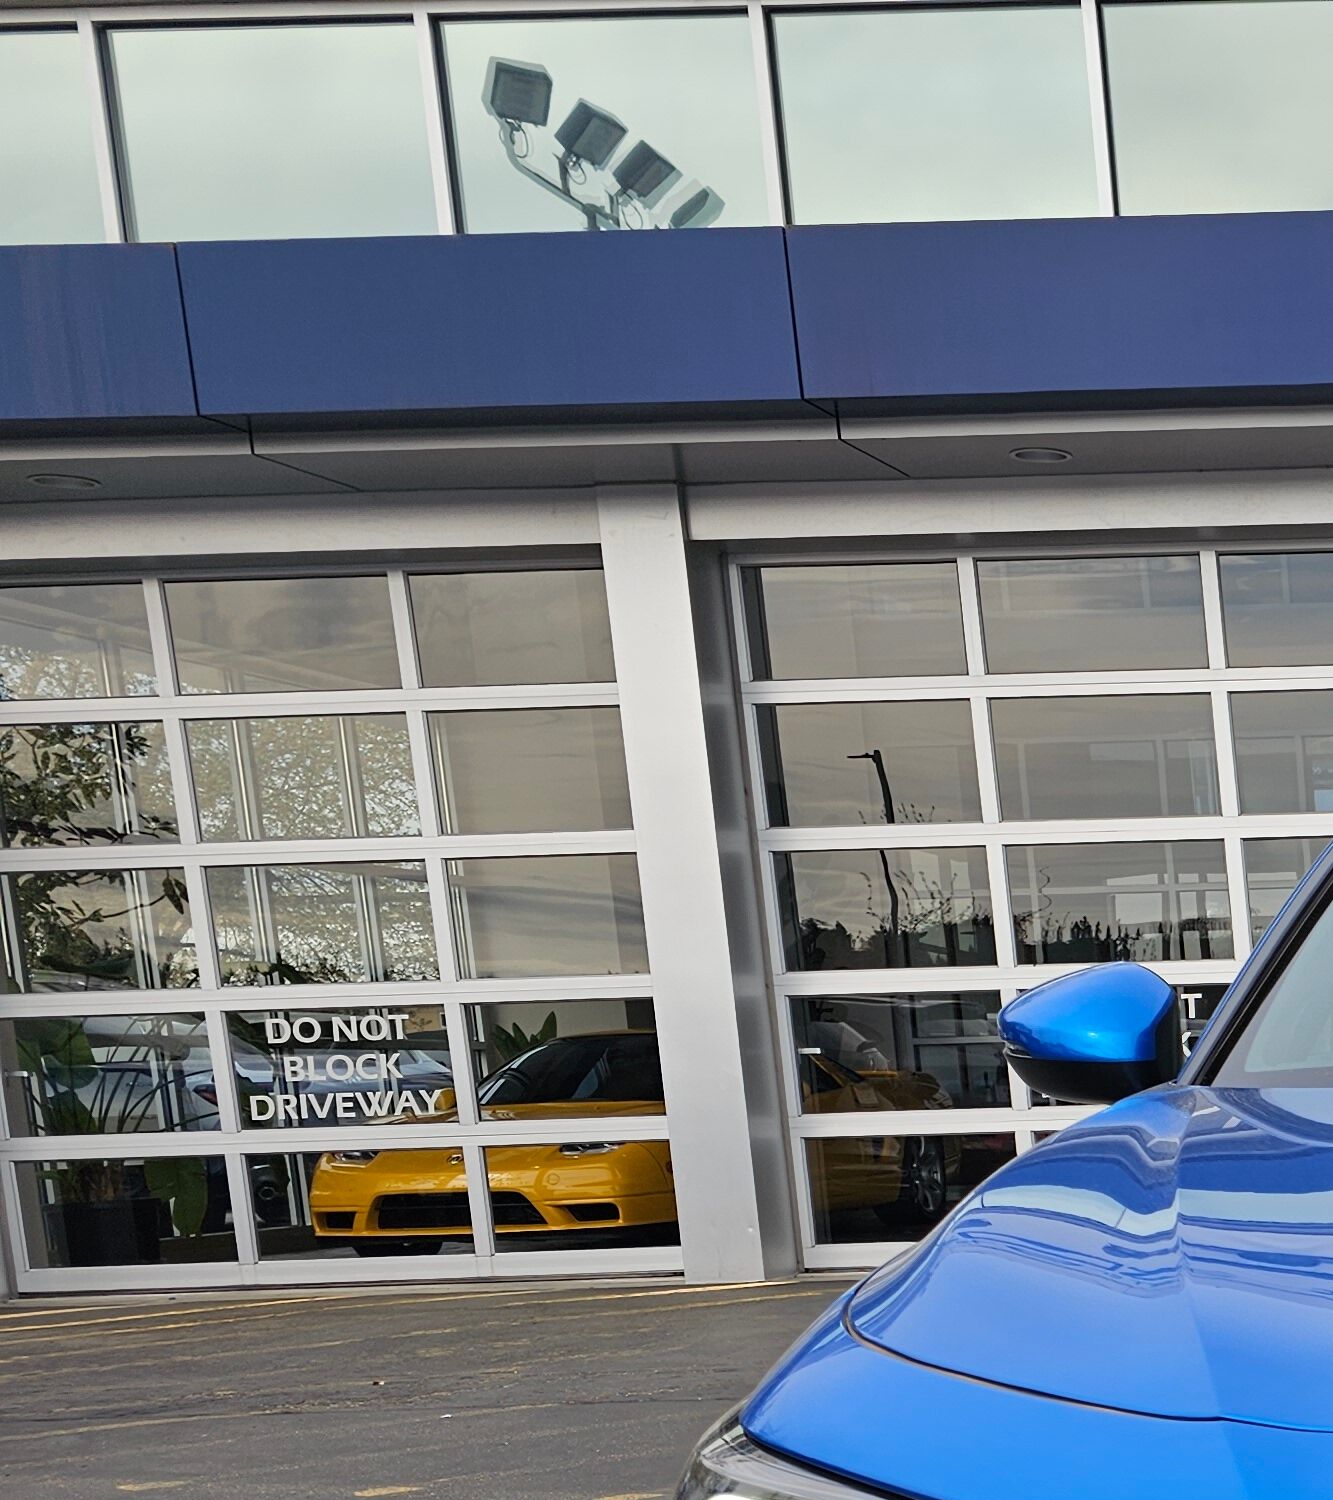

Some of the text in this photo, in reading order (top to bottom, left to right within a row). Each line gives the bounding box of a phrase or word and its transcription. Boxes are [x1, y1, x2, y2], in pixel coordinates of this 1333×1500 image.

[265, 1014, 409, 1045] DO NOT
[283, 1052, 404, 1082] BLOCK
[249, 1089, 441, 1122] DRIVEWAY
